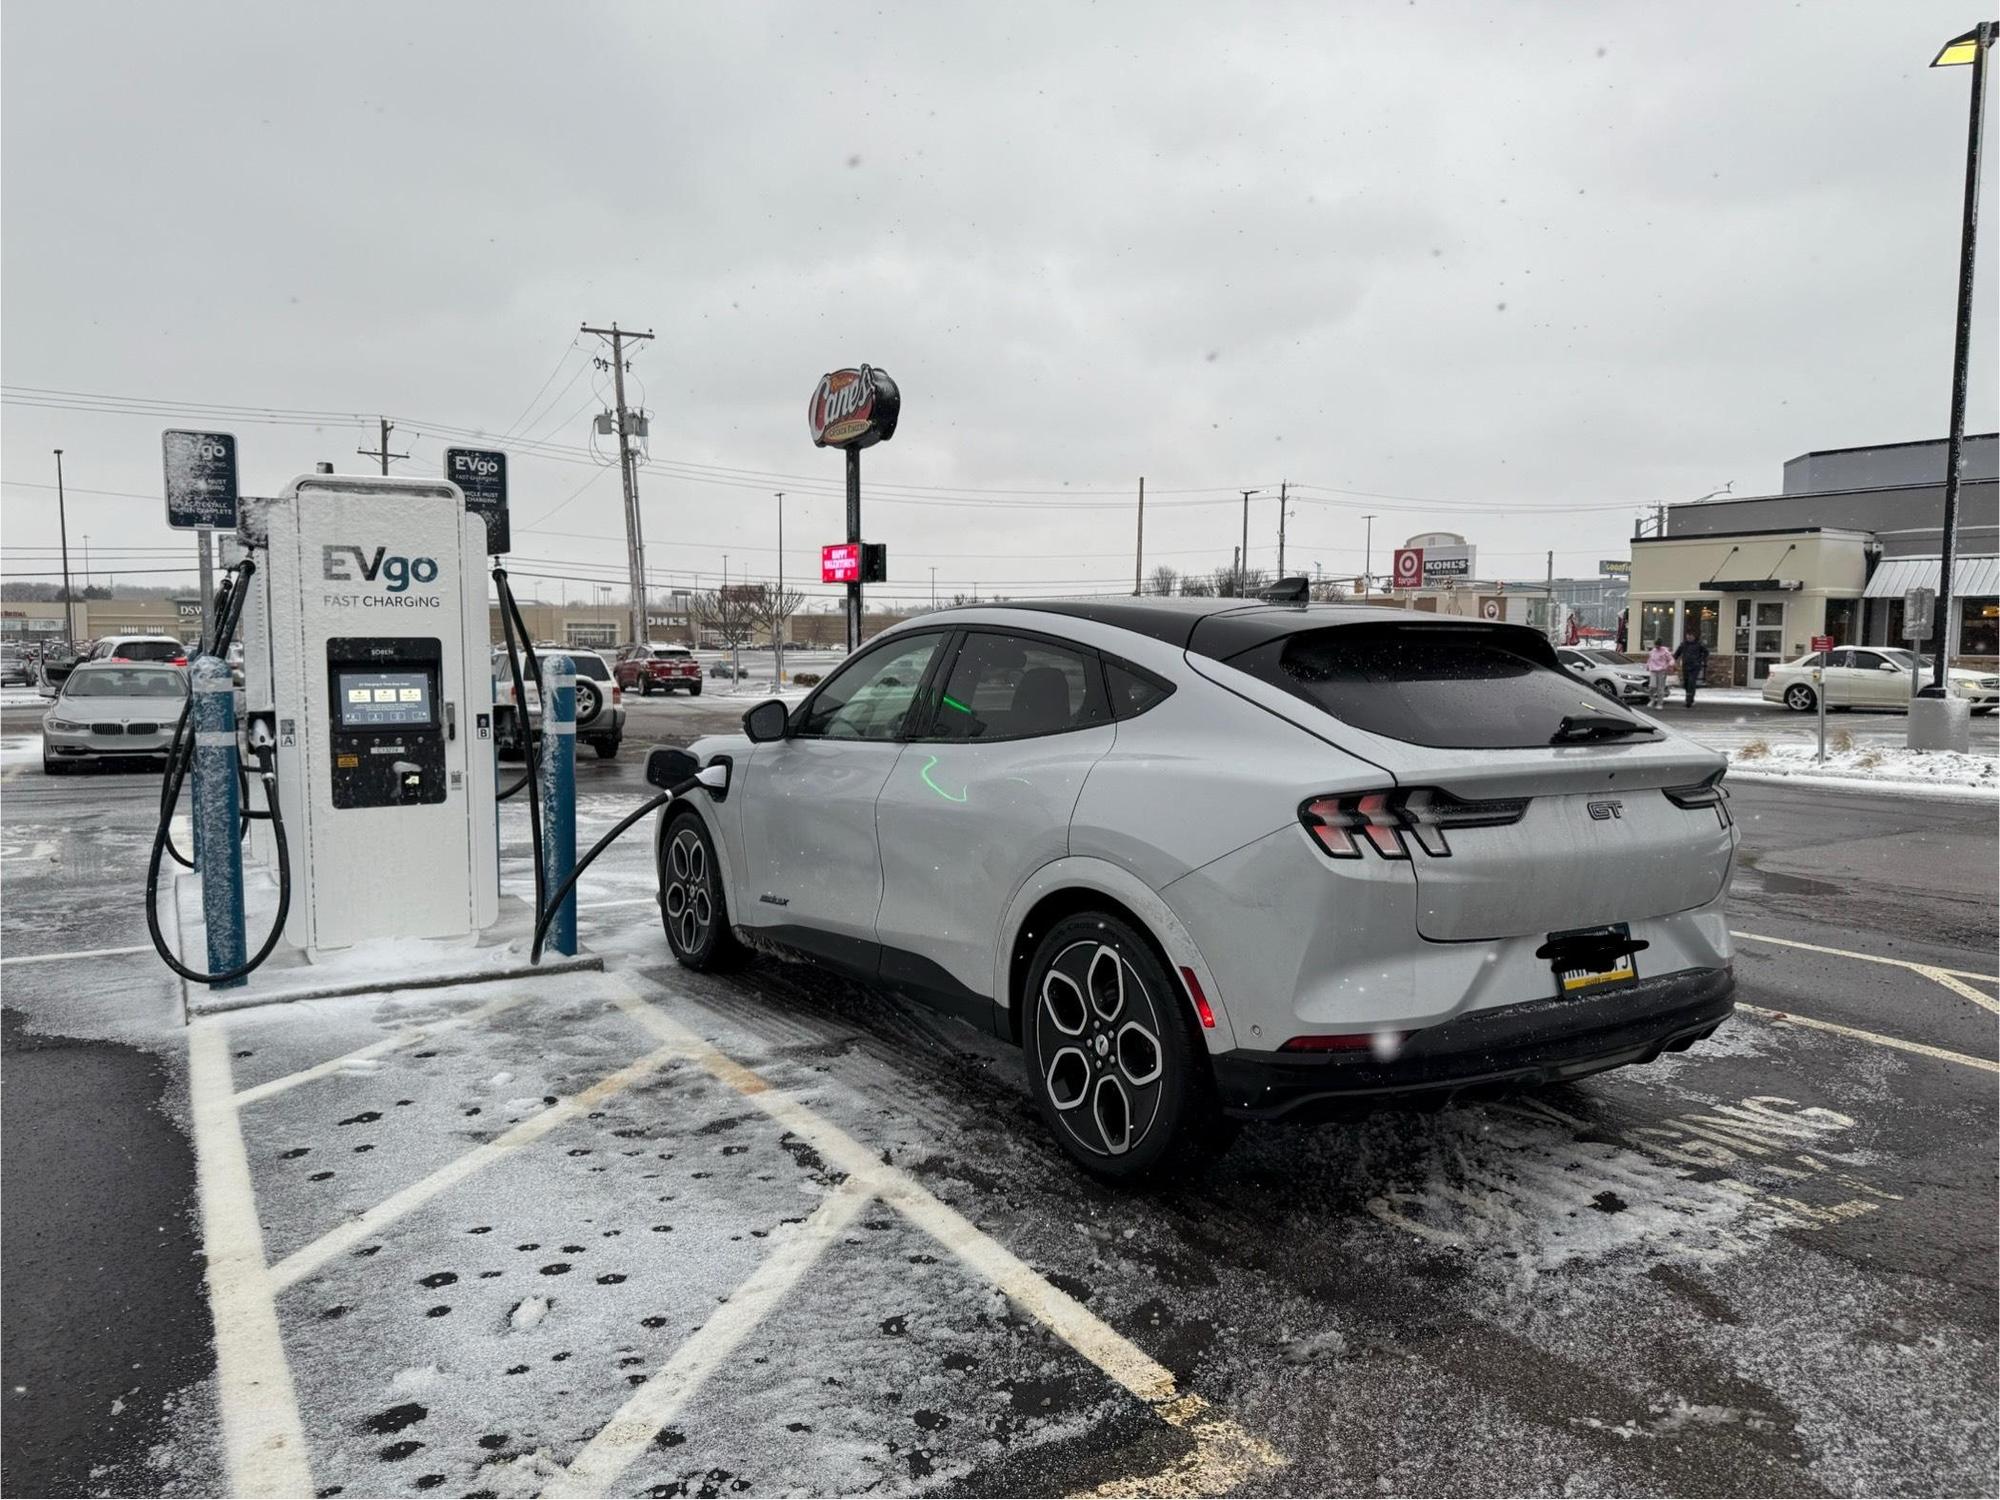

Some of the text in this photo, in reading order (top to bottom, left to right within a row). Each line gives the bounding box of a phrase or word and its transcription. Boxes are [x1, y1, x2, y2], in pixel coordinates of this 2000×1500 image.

[455, 456, 498, 476] EVgo
[322, 544, 439, 593] EVgo
[1425, 560, 1466, 570] KOHL'S
[1398, 577, 1418, 587] target
[323, 595, 440, 608] FAST CHARGING
[647, 616, 689, 626] OHL'S
[480, 728, 488, 738] B
[283, 735, 293, 745] A
[1586, 800, 1624, 821] GT
